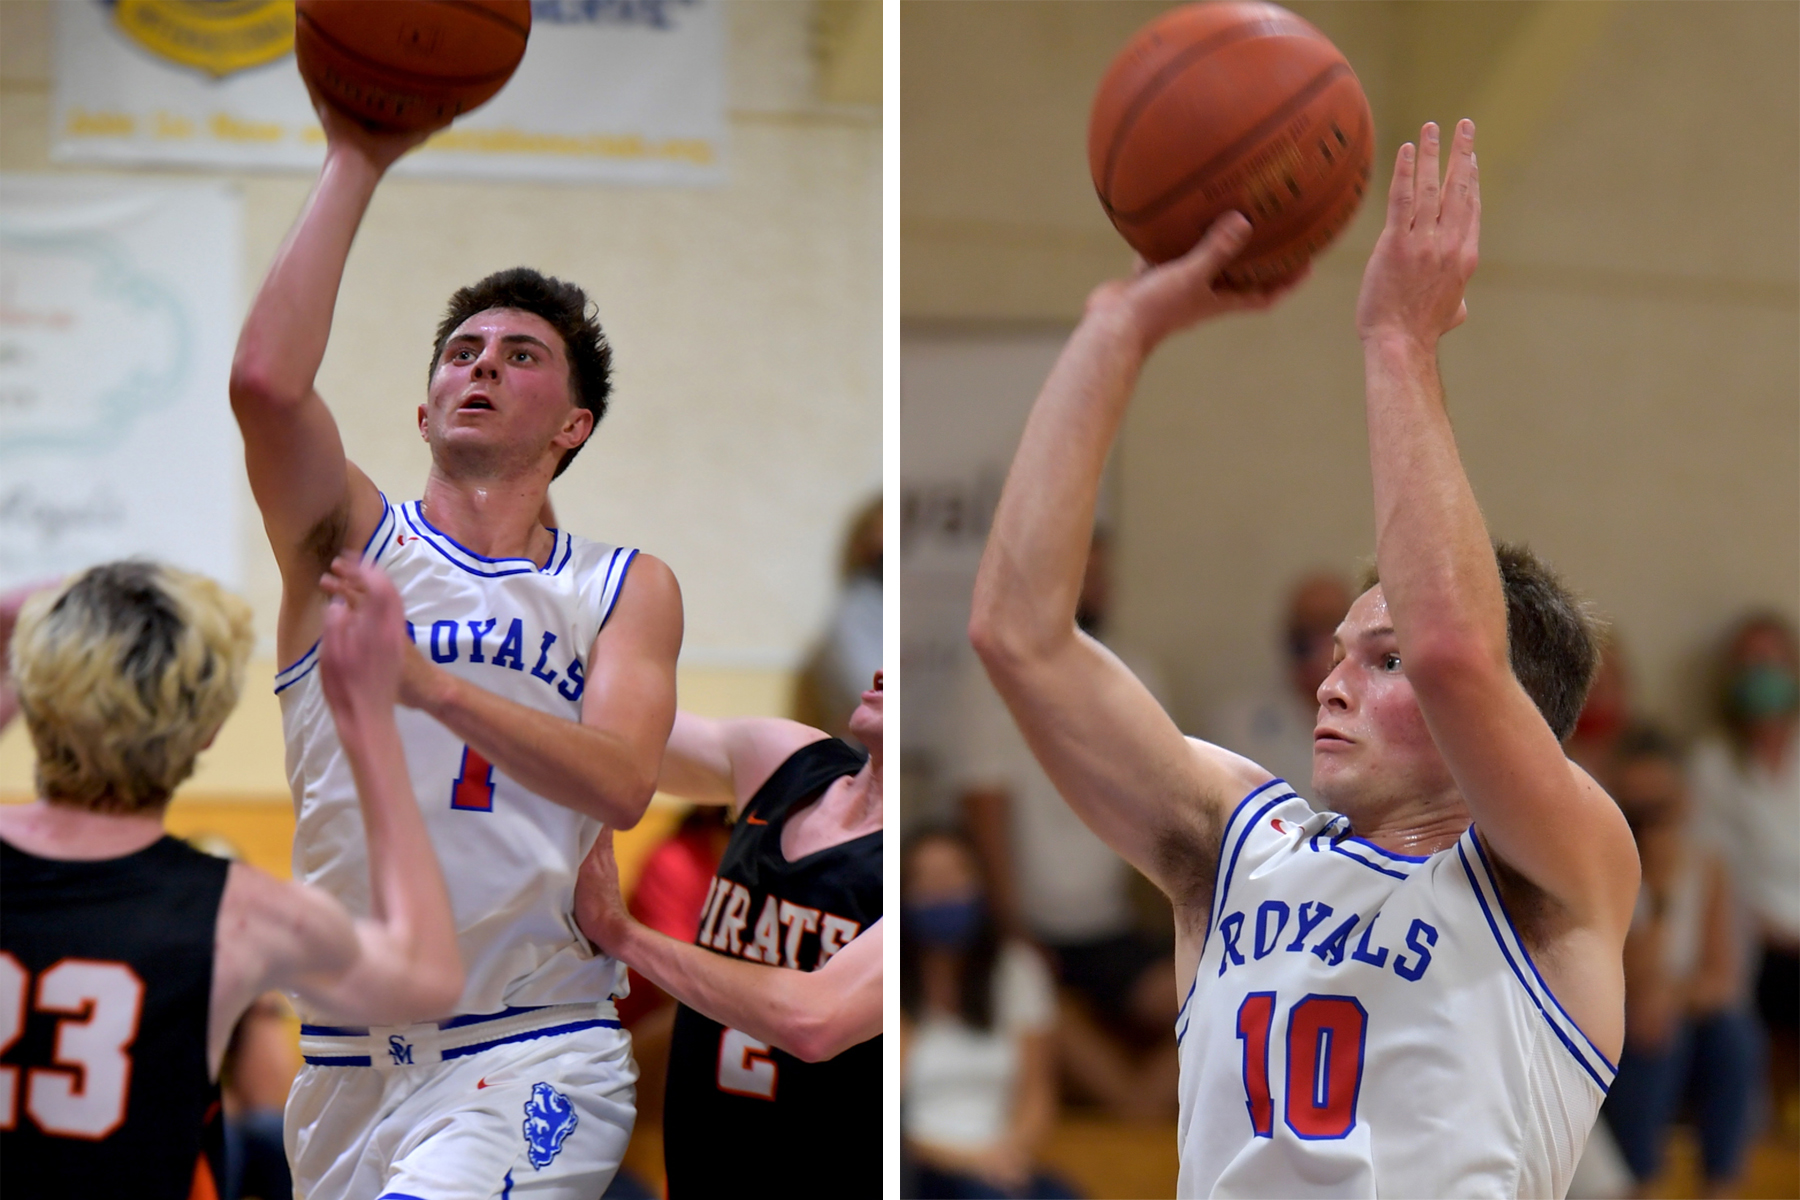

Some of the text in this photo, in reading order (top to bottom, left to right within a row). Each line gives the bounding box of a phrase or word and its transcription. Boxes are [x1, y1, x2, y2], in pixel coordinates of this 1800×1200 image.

[405, 617, 585, 702] OYALS
[450, 743, 496, 813] 1
[700, 874, 861, 971] IRATE
[1218, 899, 1439, 983] ROYALS
[1235, 990, 1369, 1141] 10
